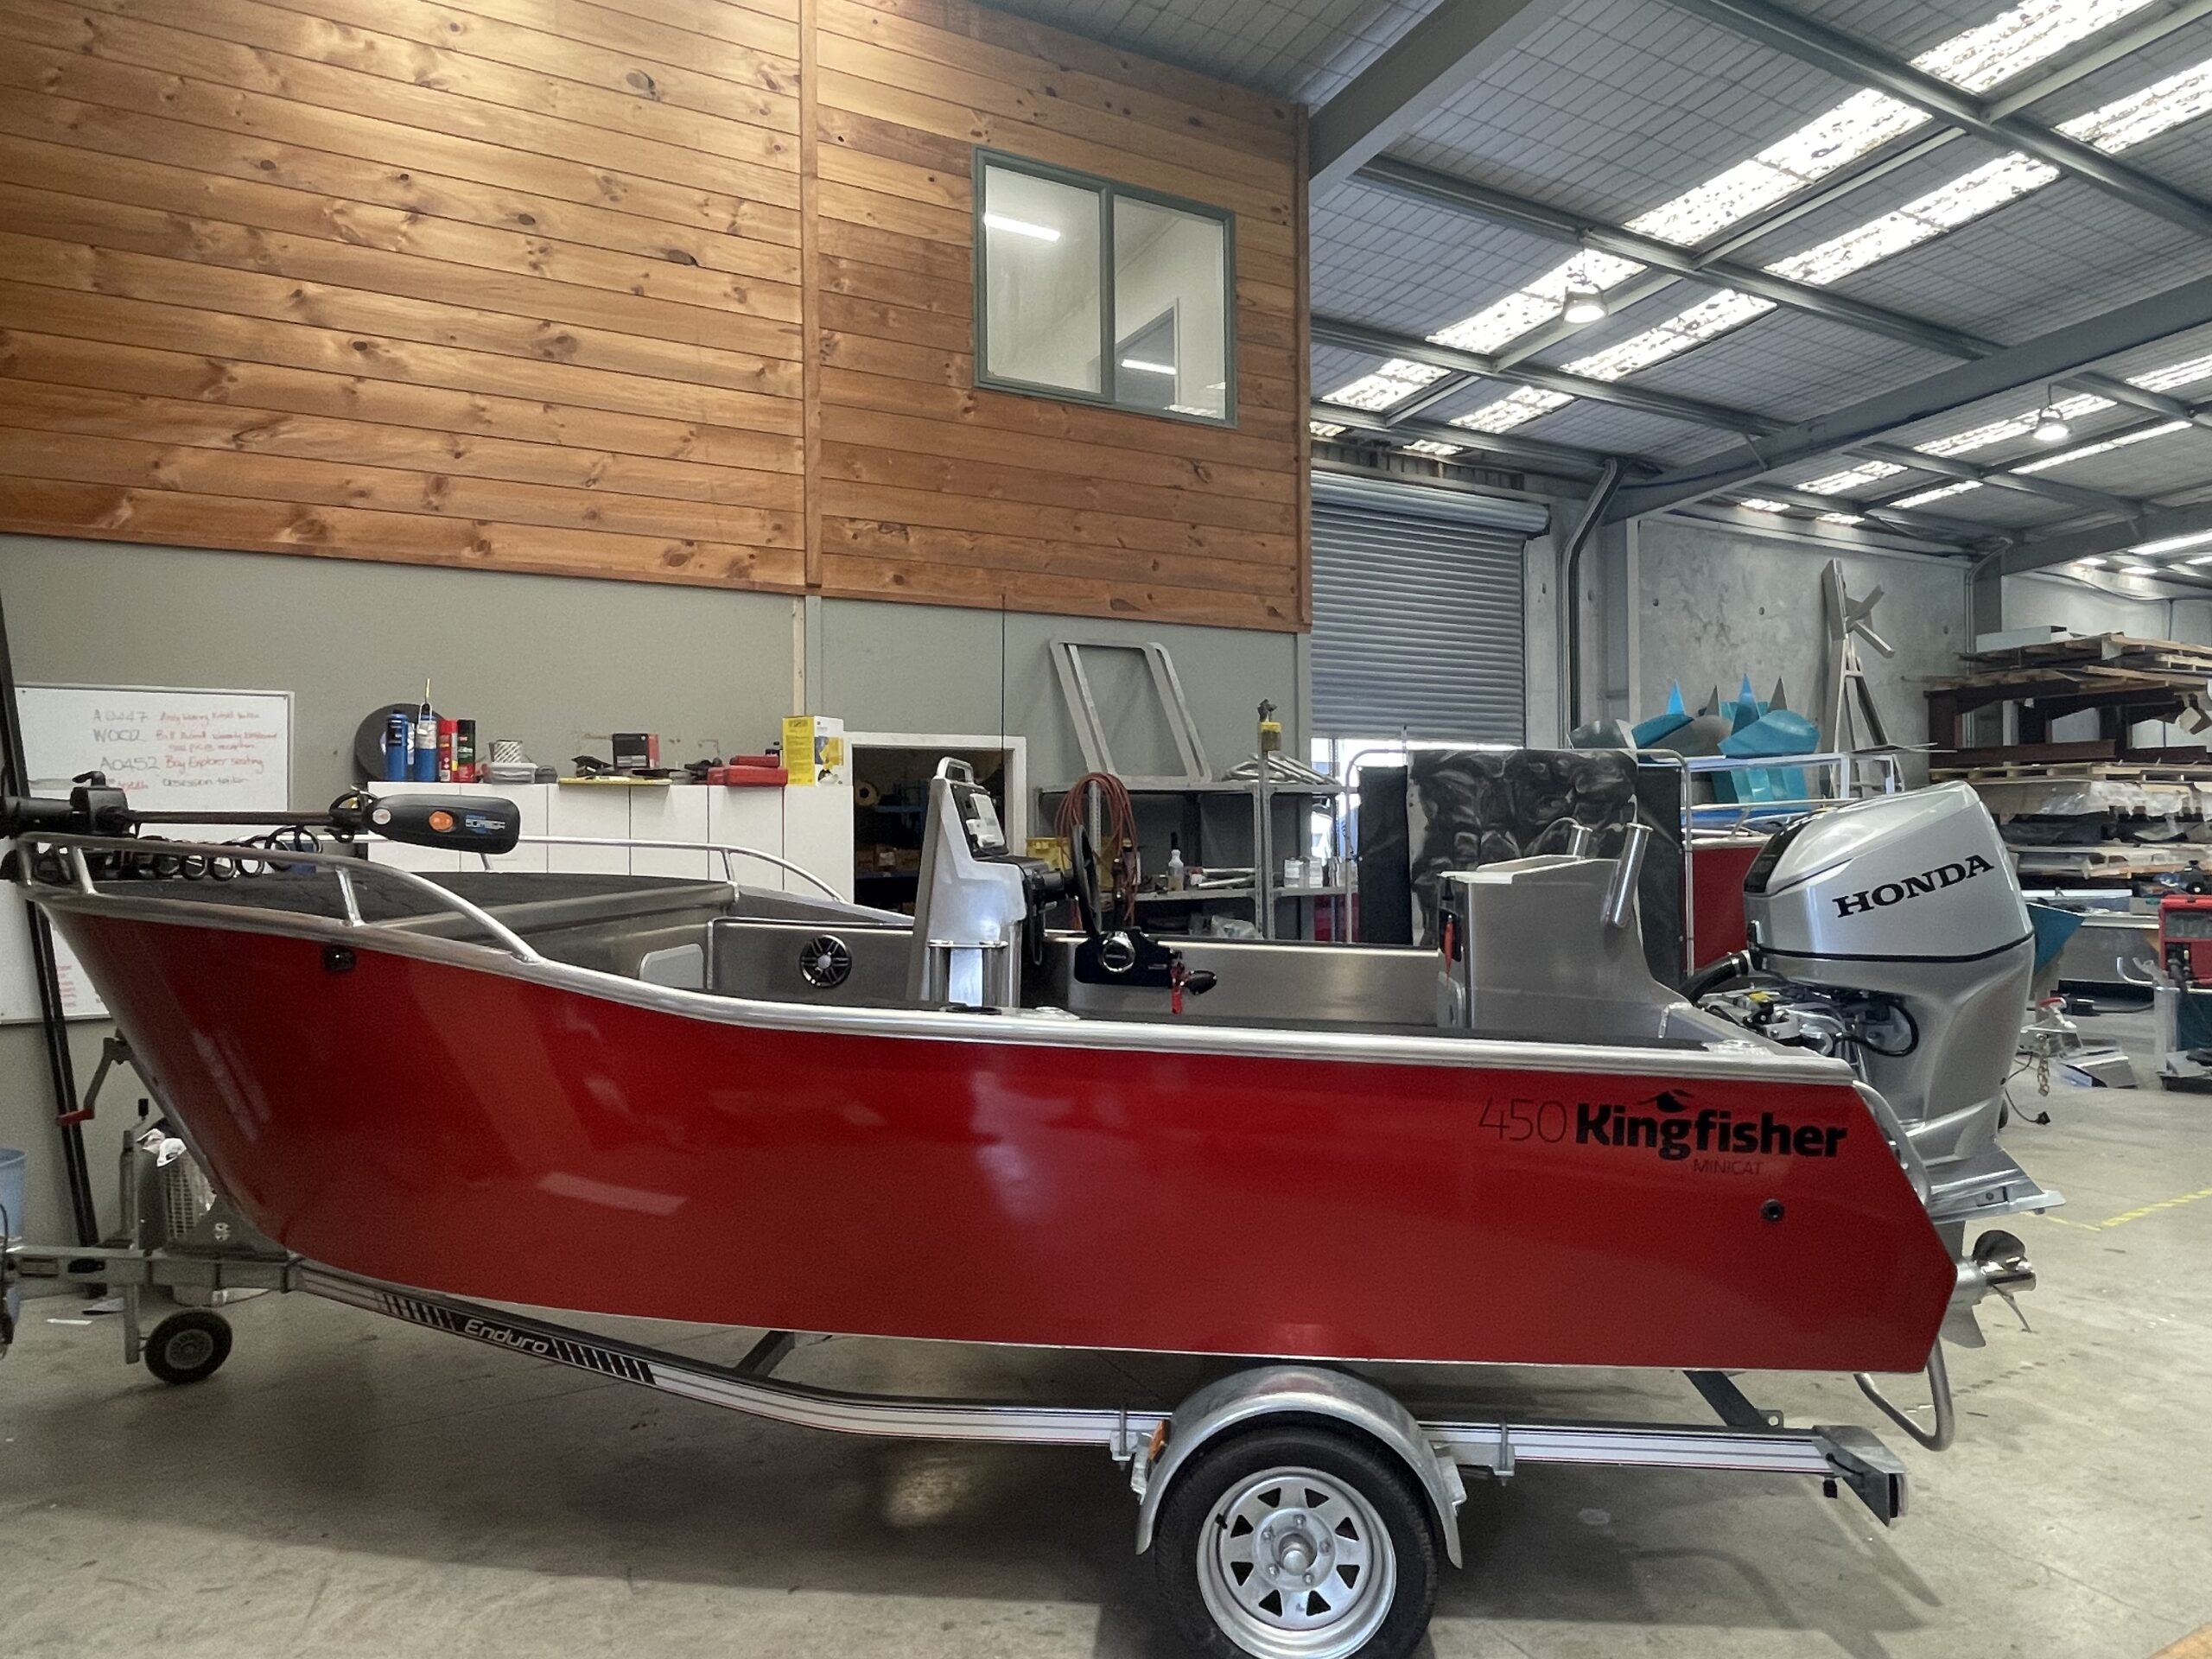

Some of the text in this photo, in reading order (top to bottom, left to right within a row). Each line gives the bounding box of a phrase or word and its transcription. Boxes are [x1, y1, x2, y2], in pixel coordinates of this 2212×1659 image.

[99, 755, 161, 771] A0452
[1832, 855, 1995, 918] HONDA
[1478, 1097, 1848, 1161] 450 Kingfisher
[1693, 1159, 1764, 1175] MINICAT
[464, 1319, 550, 1354] Enduro
